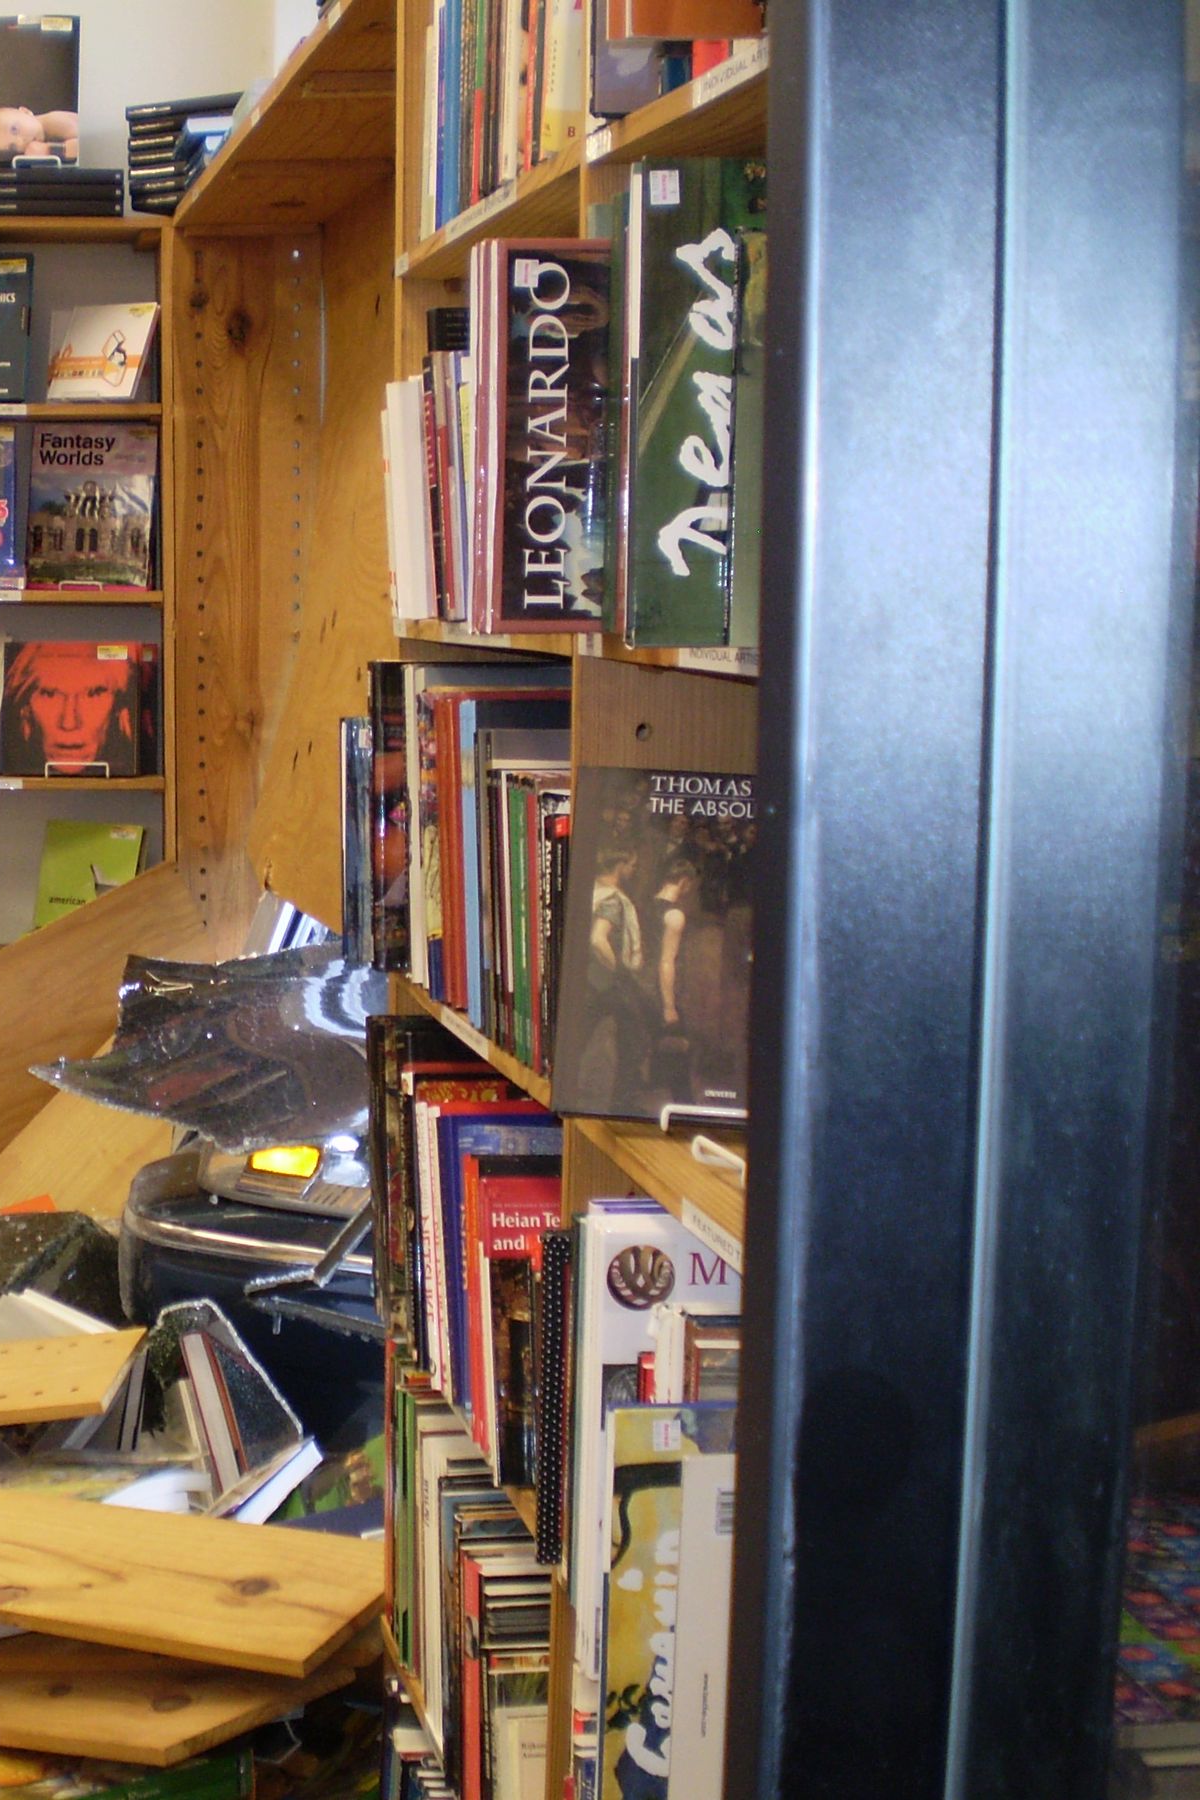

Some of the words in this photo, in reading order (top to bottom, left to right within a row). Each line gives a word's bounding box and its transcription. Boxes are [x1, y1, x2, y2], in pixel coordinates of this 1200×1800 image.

[39, 432, 116, 454] Fantasy
[524, 262, 570, 609] LEONARDO
[39, 450, 105, 467] Worlds
[650, 775, 752, 797] THOMAS
[650, 797, 685, 815] THE
[691, 800, 754, 819] ABSOL
[544, 840, 552, 904] African
[49, 895, 87, 907] american
[491, 1212, 541, 1228] Heian
[543, 1212, 560, 1228] Te
[493, 1235, 525, 1251] and
[688, 1252, 727, 1286] M
